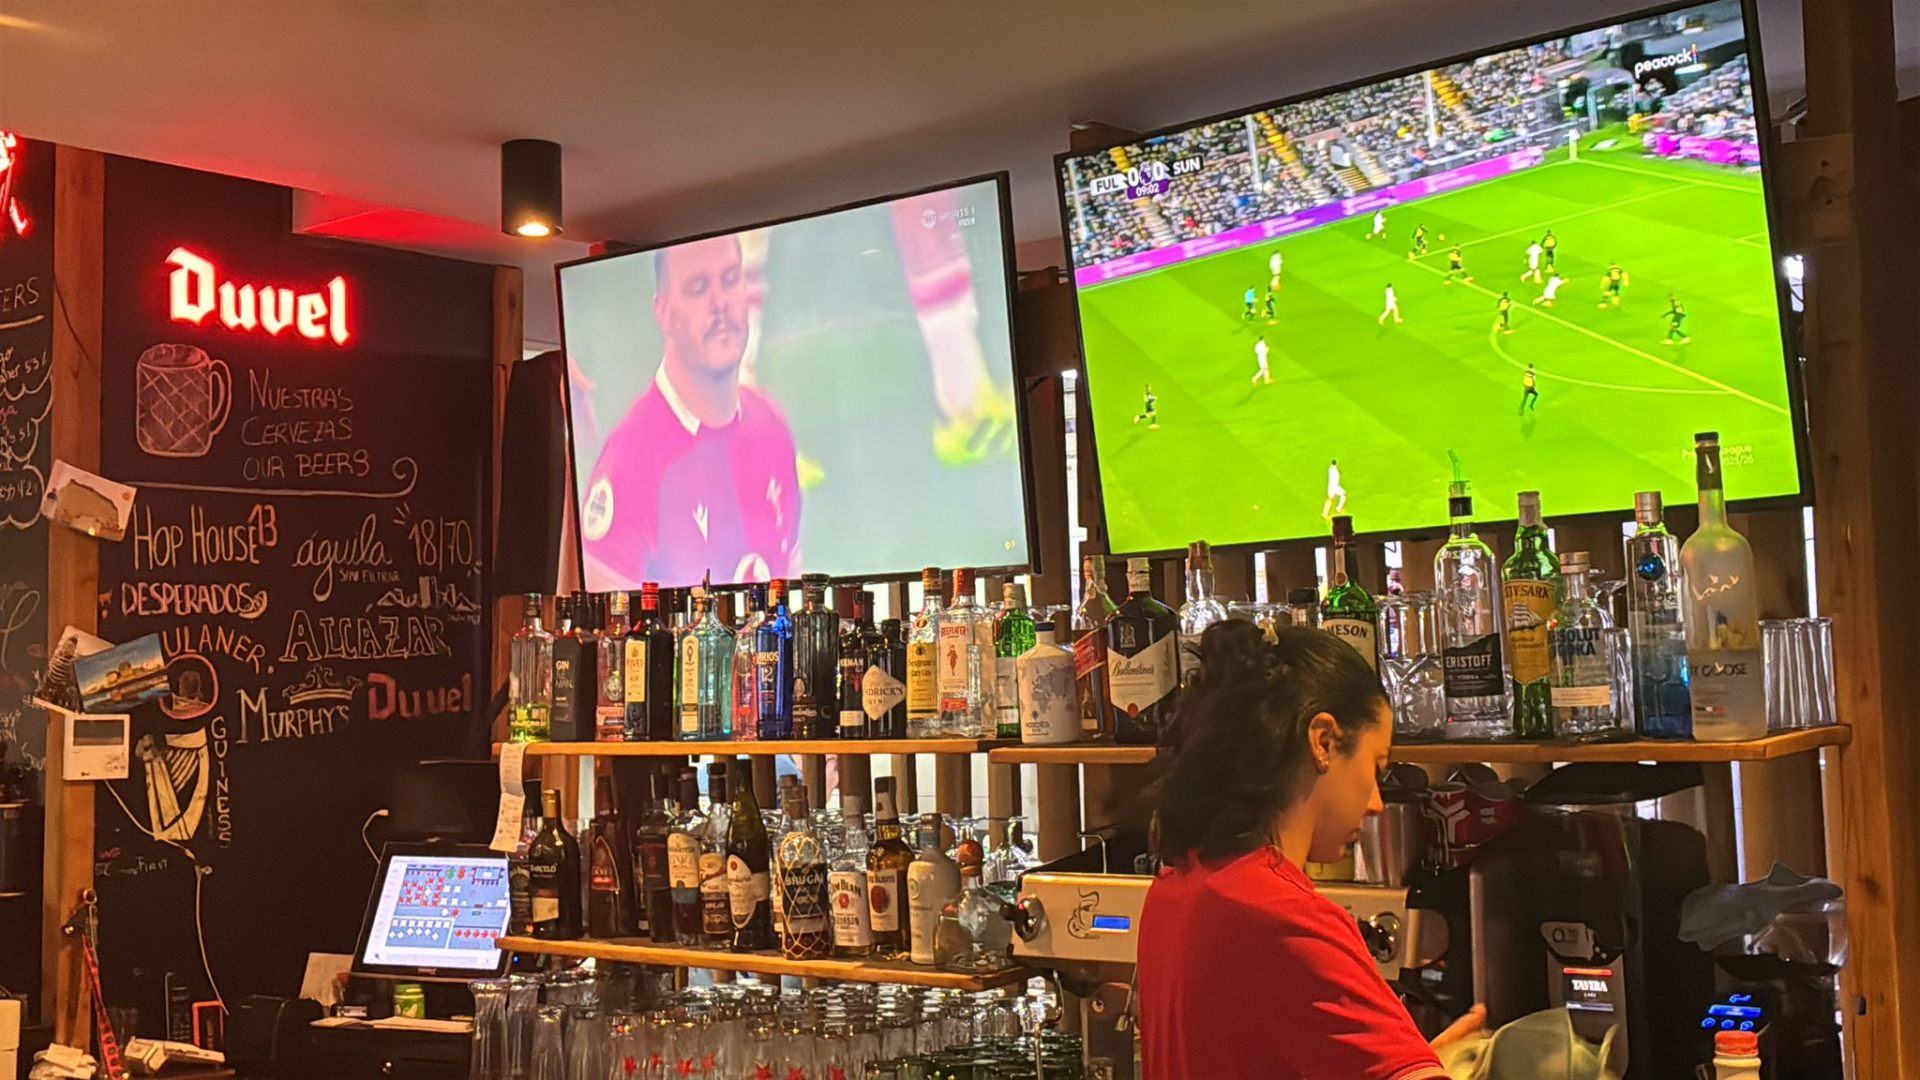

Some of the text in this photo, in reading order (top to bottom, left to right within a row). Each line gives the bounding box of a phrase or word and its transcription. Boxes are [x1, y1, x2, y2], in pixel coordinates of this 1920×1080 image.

[1634, 47, 1693, 79] peacock
[1096, 157, 1201, 192] FUL 0 0 SUN
[1135, 184, 1160, 197] 09:02
[165, 246, 351, 344] Duvel
[248, 367, 354, 412] NUESTRAS
[241, 416, 353, 446] CERVEZAS
[243, 449, 370, 481] OUR BEERS
[133, 504, 184, 570] HOP
[190, 504, 261, 566] HOUSE
[292, 513, 393, 602] águila
[121, 582, 254, 616] DESPERADOS
[279, 610, 452, 662] ALCAZAR
[1446, 654, 1492, 668] ERISTOFF
[235, 687, 350, 744] MURPHY'S
